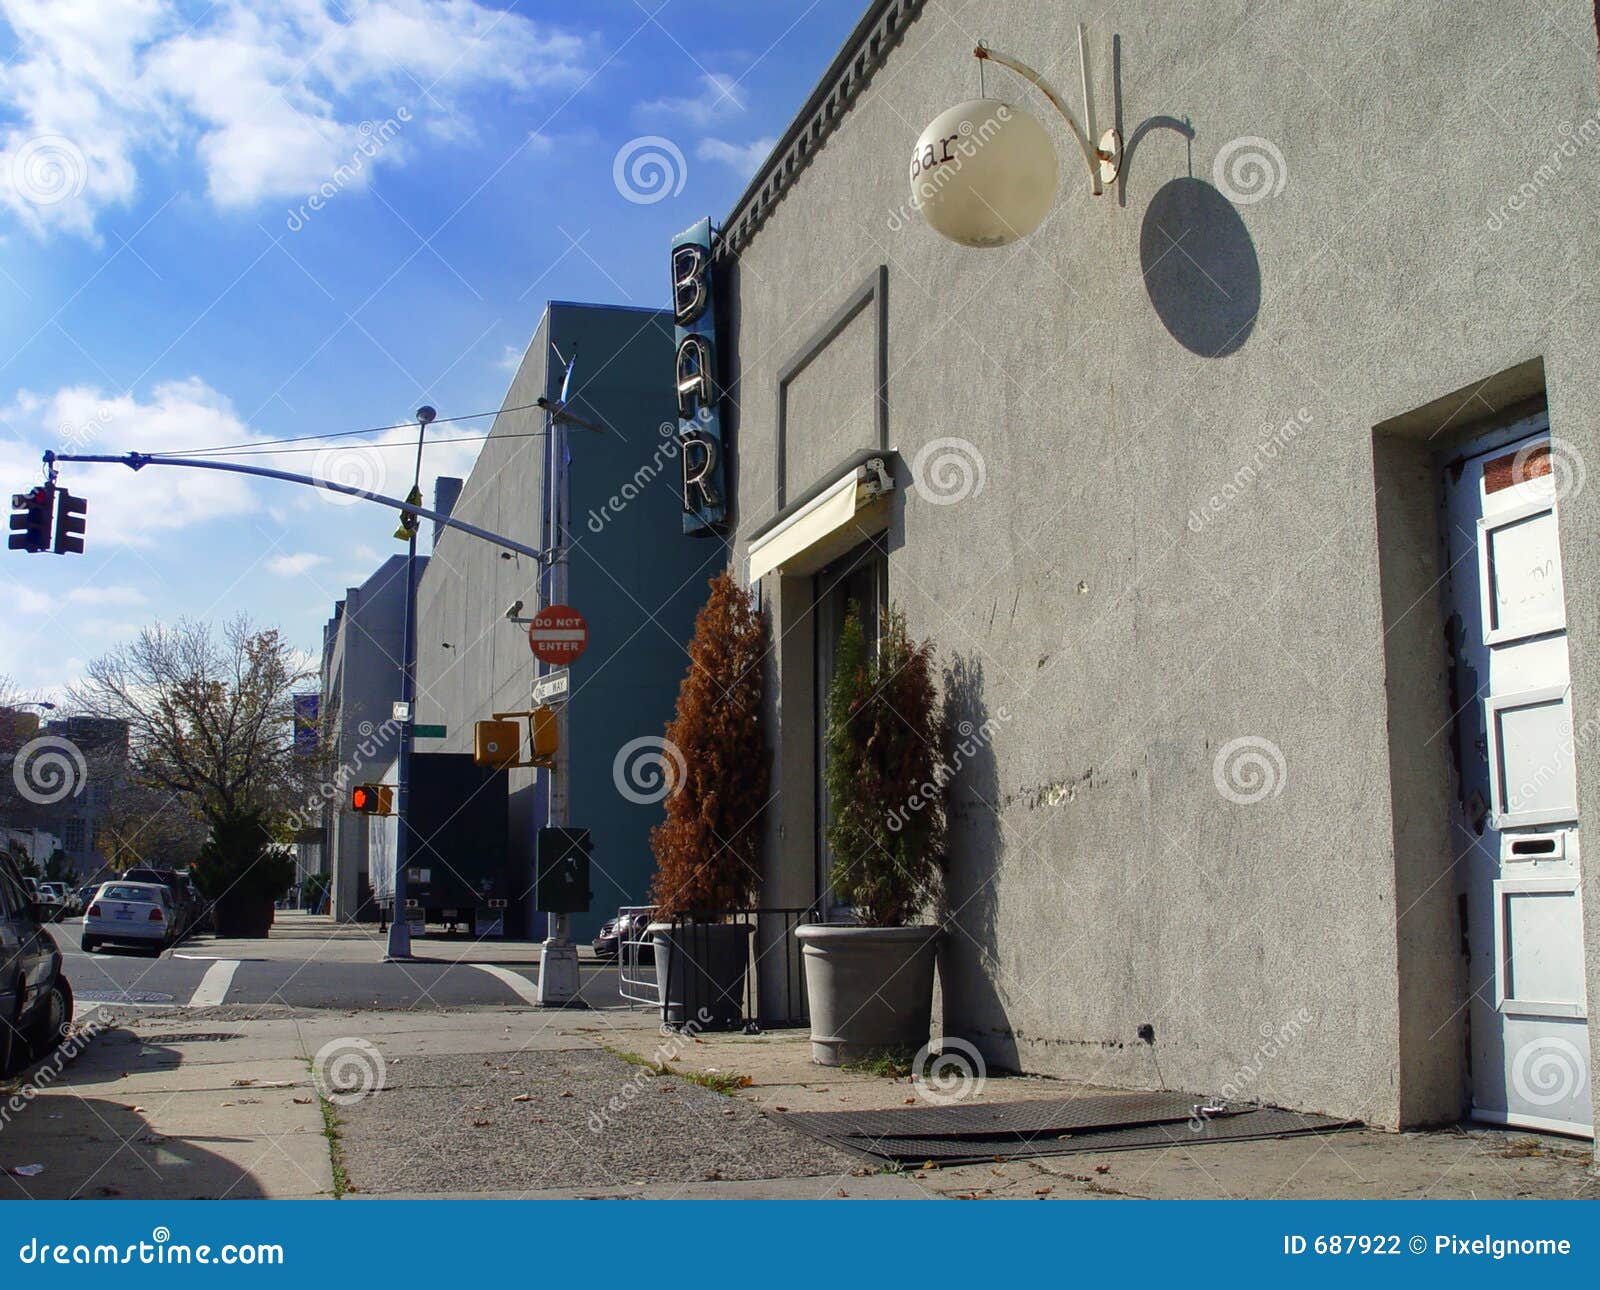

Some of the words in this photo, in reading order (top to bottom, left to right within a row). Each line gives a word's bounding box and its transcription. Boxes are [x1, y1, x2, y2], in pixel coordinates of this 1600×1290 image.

[672, 242, 721, 514] BAR
[535, 618, 552, 628] DO
[556, 618, 580, 628] NOT
[538, 641, 579, 652] ENTER
[552, 678, 566, 693] WAY
